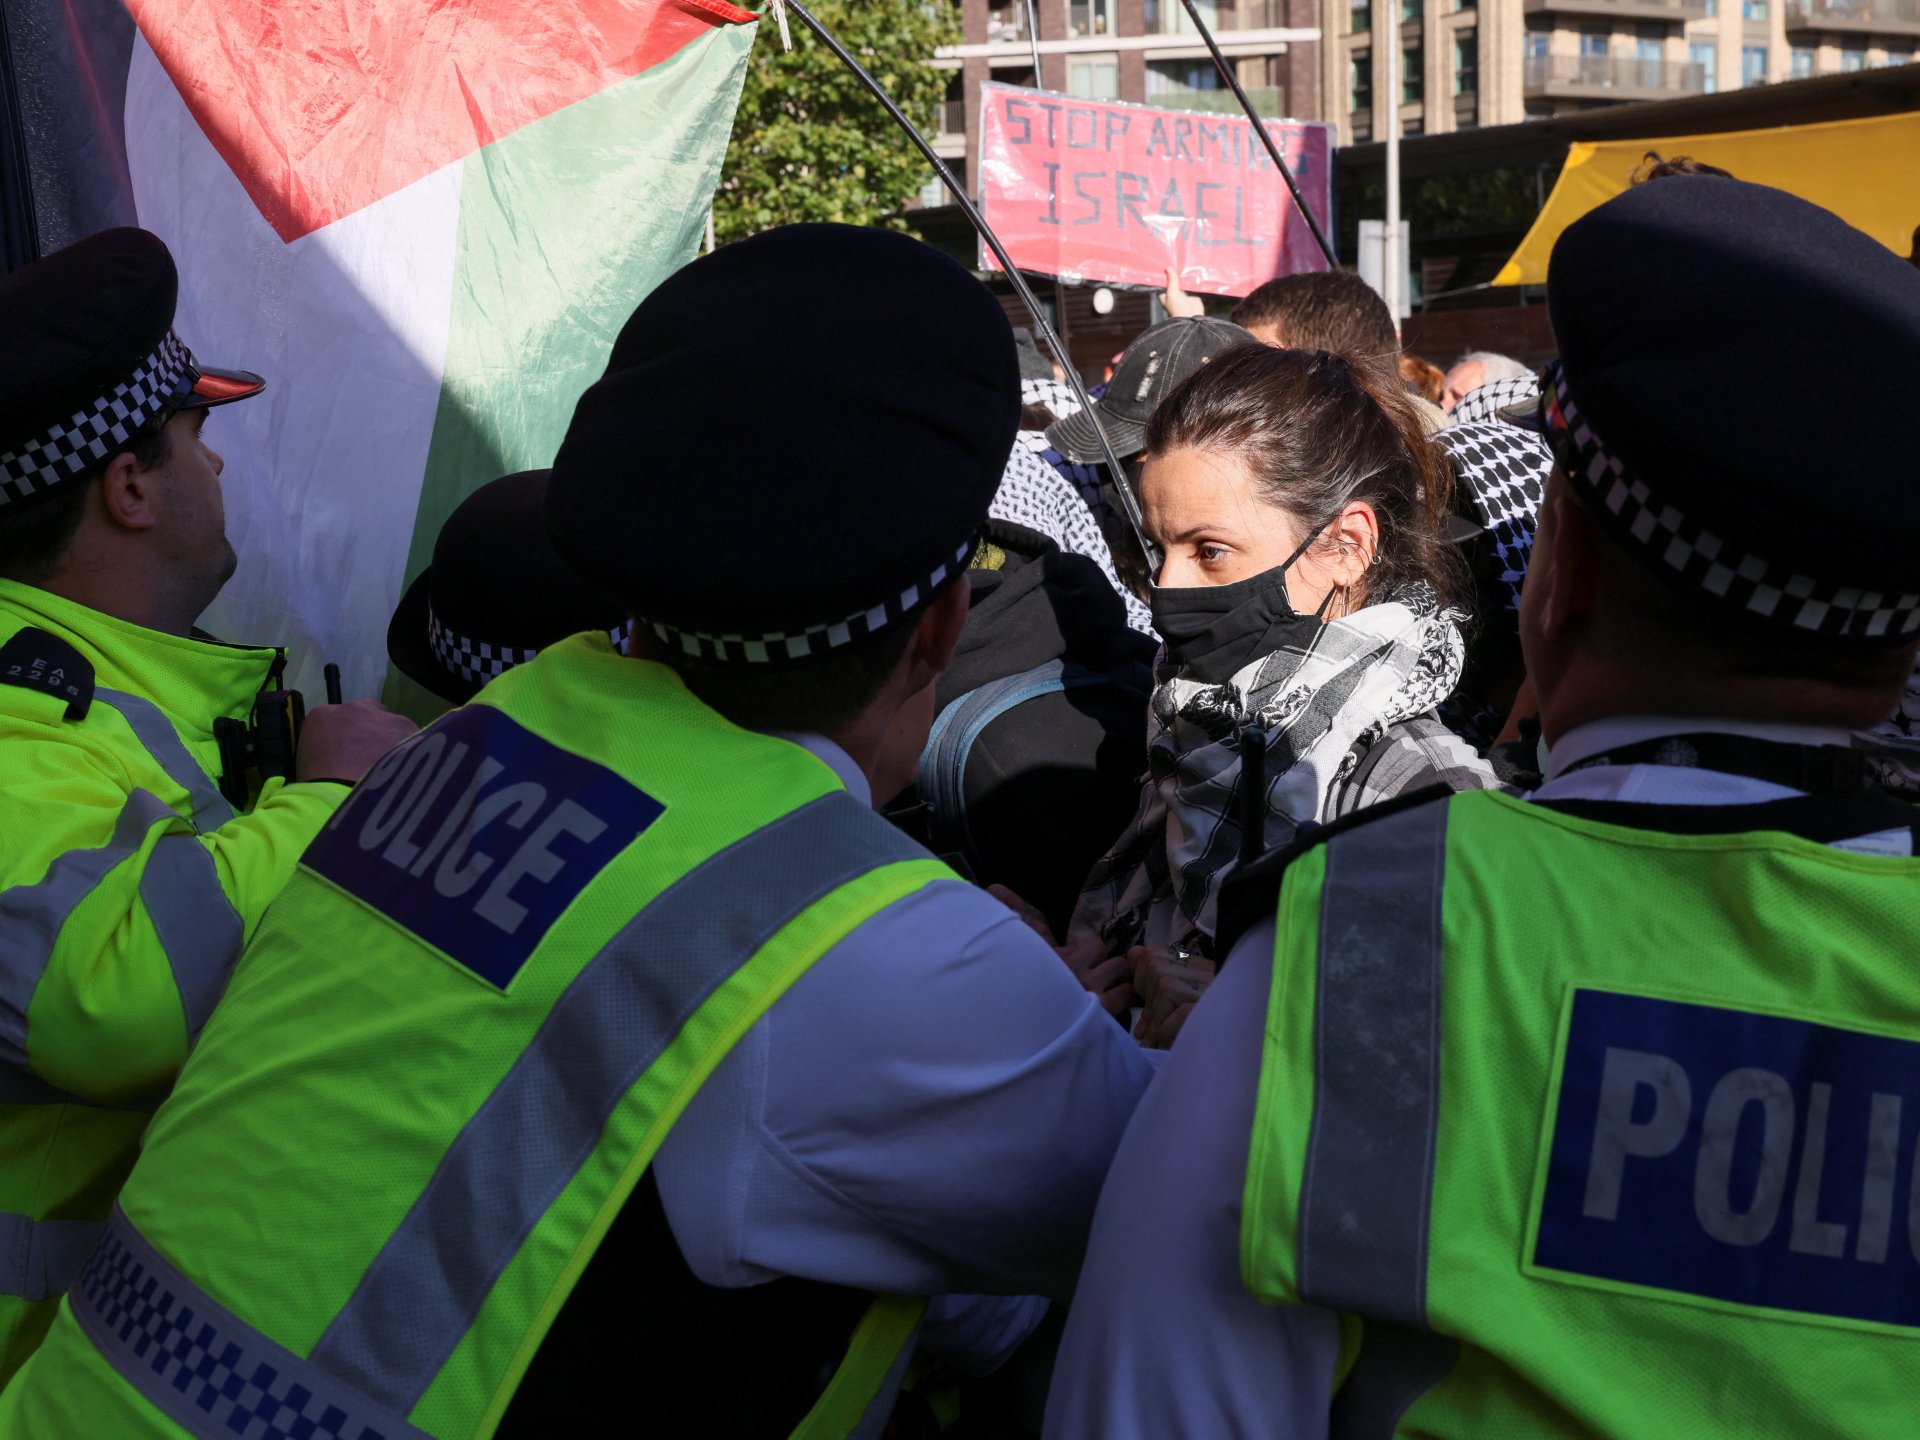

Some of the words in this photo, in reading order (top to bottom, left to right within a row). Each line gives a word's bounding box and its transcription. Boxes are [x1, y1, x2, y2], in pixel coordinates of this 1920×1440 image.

[1005, 99, 1131, 152] STOP
[1146, 116, 1308, 176] ARMING
[1037, 161, 1267, 247] ISRAEL
[328, 732, 609, 935] POLICE
[1582, 1045, 1920, 1267] POLI
